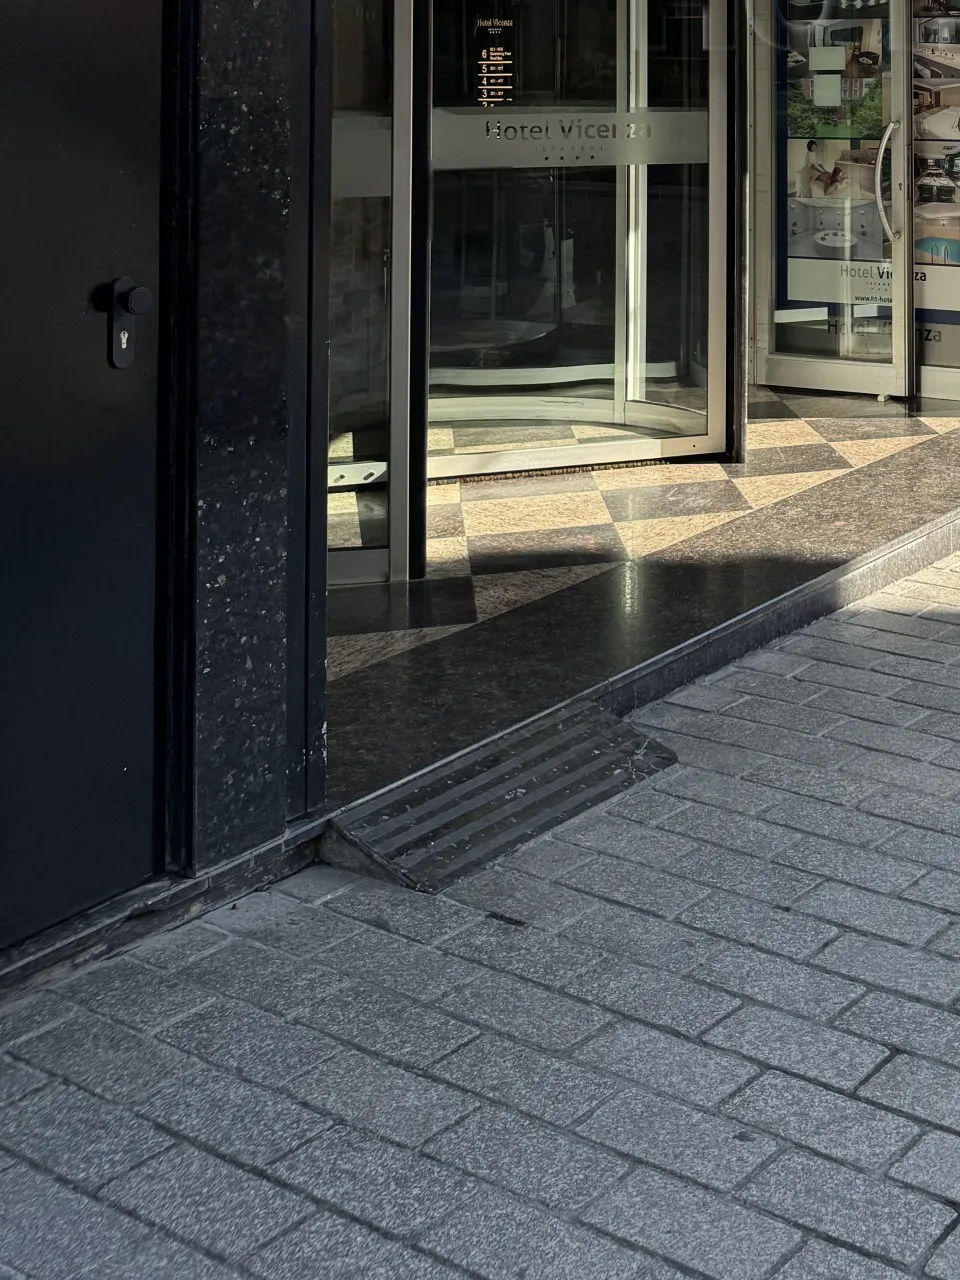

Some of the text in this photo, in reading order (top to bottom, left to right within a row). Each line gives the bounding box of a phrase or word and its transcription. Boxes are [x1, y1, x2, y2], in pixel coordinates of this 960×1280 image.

[481, 49, 487, 59] 6
[481, 64, 488, 74] 5
[481, 76, 488, 86] 4
[481, 89, 488, 98] 3
[486, 120, 552, 141] Hotel
[840, 264, 874, 279] Hotel
[854, 295, 893, 304] www.ht-hote
